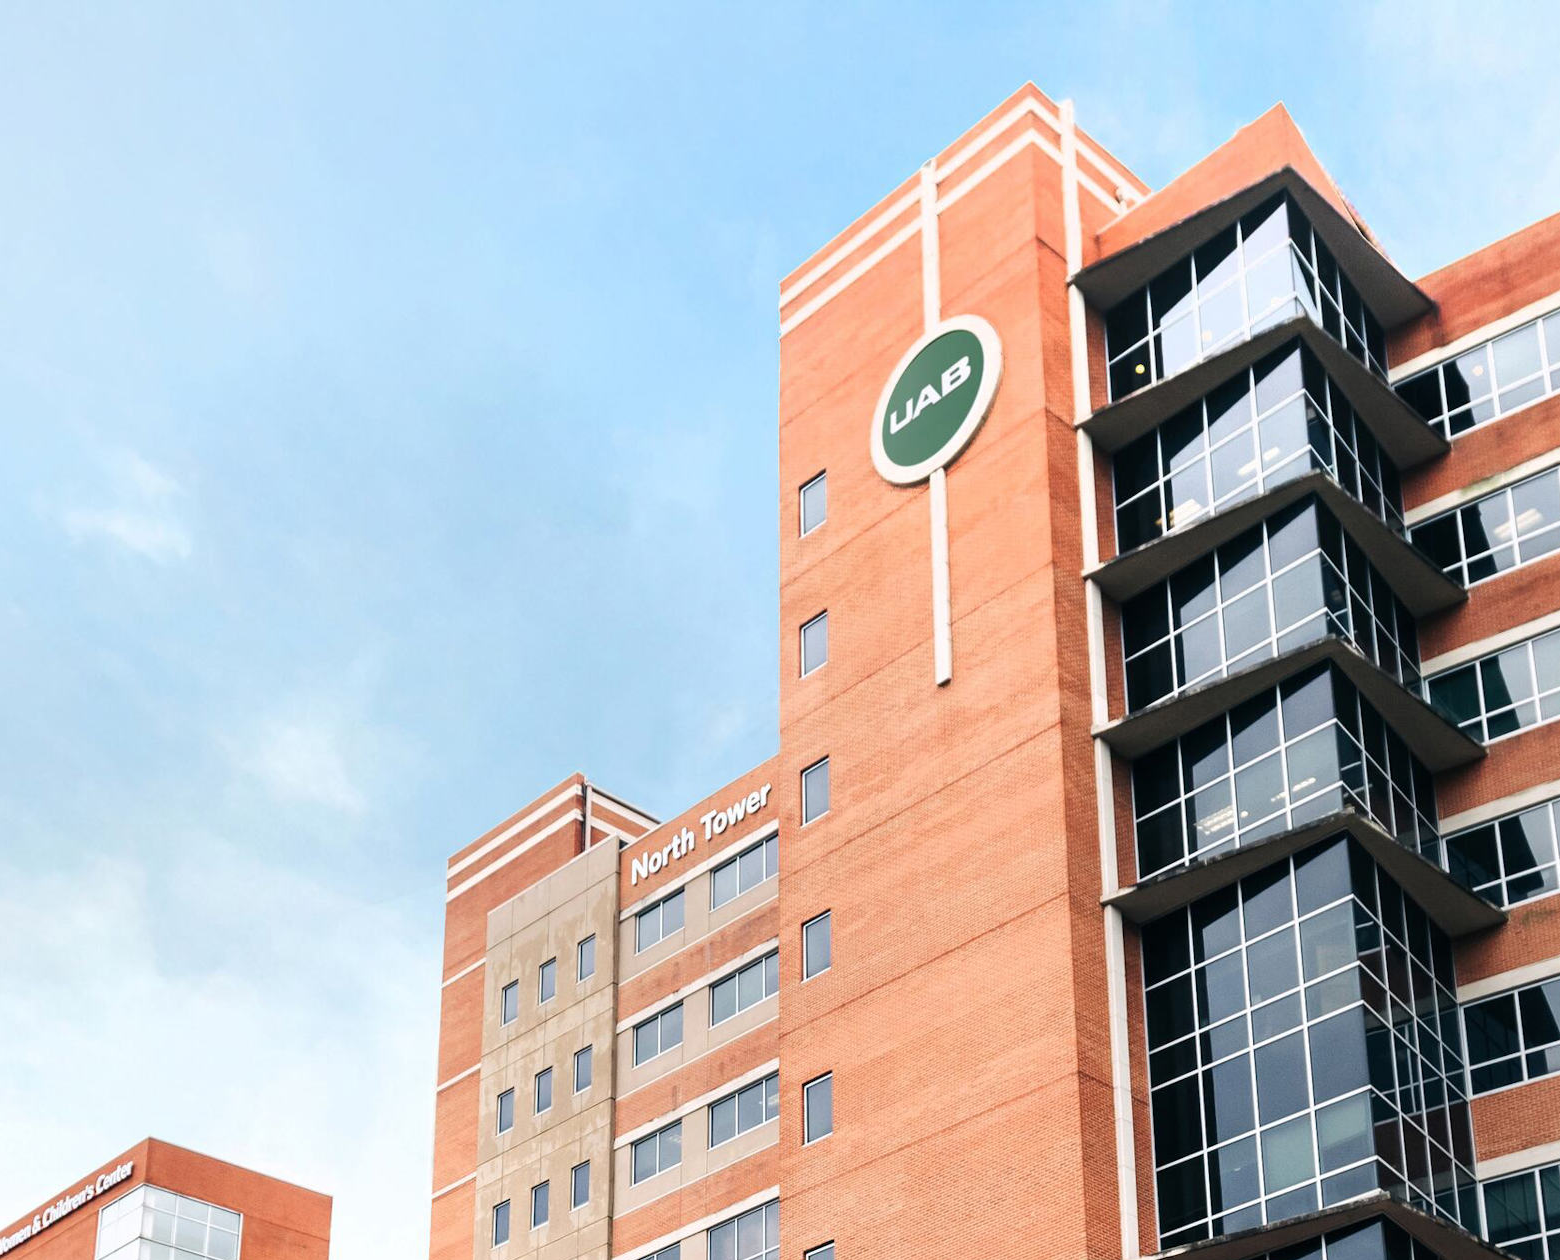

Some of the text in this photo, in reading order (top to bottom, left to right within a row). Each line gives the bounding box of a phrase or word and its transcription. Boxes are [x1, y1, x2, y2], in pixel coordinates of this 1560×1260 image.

[890, 356, 971, 434] UAB
[631, 783, 772, 885] North Tower
[32, 1216, 43, 1234] &
[43, 1184, 95, 1228] Children's
[95, 1161, 134, 1194] Center
